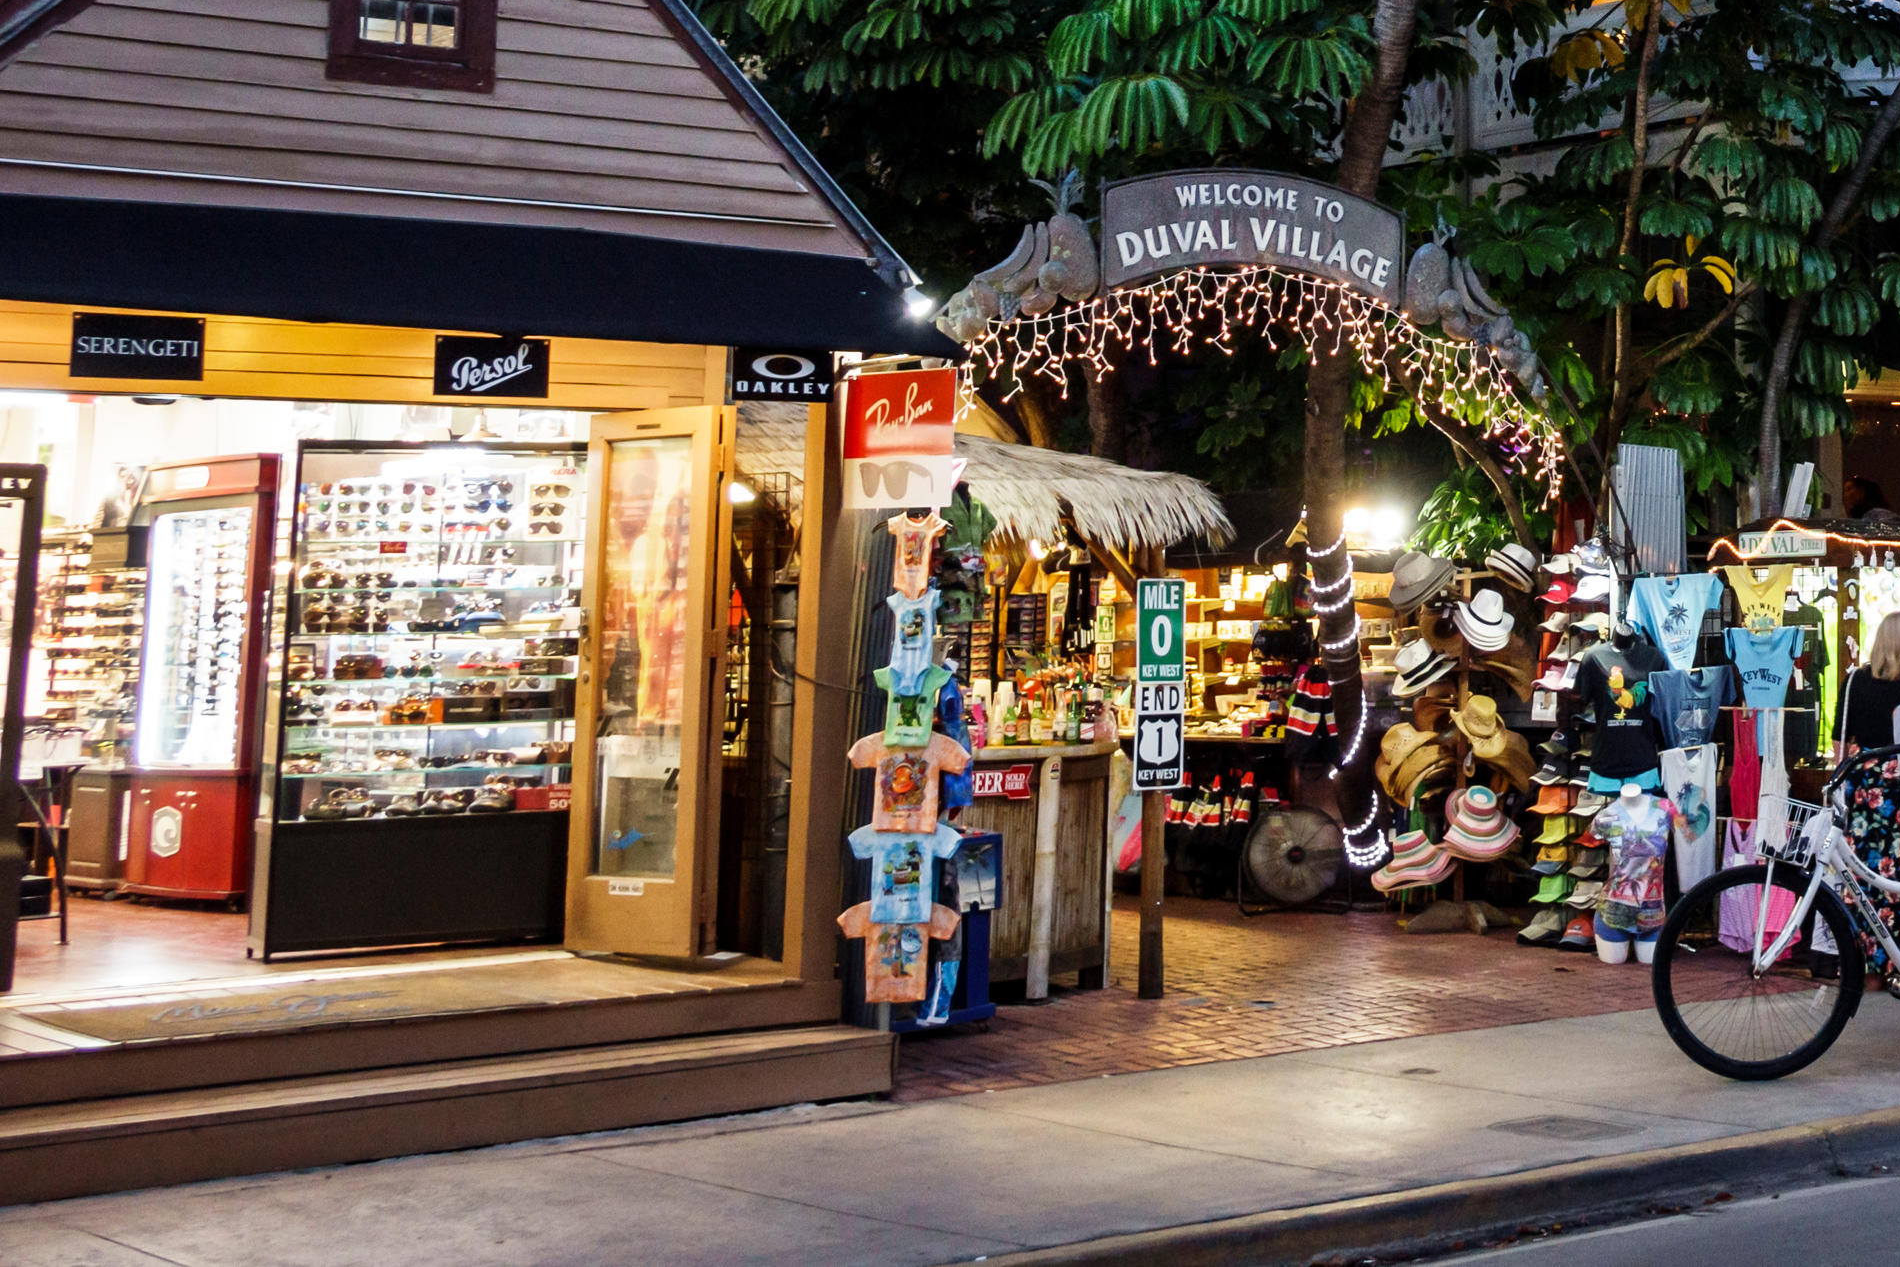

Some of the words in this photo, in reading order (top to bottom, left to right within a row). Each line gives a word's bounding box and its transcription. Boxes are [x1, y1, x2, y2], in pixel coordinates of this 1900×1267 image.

[1175, 184, 1299, 212] WELCOME
[1313, 196, 1345, 223] TO
[1115, 218, 1238, 268] DUVAL
[1250, 217, 1393, 289] VILLAGE
[77, 335, 199, 358] SERENGETI
[451, 343, 533, 392] Persol
[736, 380, 830, 395] OAKLEY
[865, 382, 936, 435] Ray-Ban
[1144, 585, 1180, 610] MILE
[1151, 615, 1172, 657] 0
[1142, 664, 1159, 677] KEY
[1159, 664, 1181, 677] WEST
[1741, 670, 1760, 687] KEY
[1758, 668, 1783, 686] WEST
[1141, 686, 1180, 711] END
[1156, 726, 1163, 757] 1
[1004, 773, 1026, 782] SOLD
[1004, 781, 1025, 790] HERE
[1138, 768, 1156, 781] KEY
[1156, 767, 1180, 780] WEST
